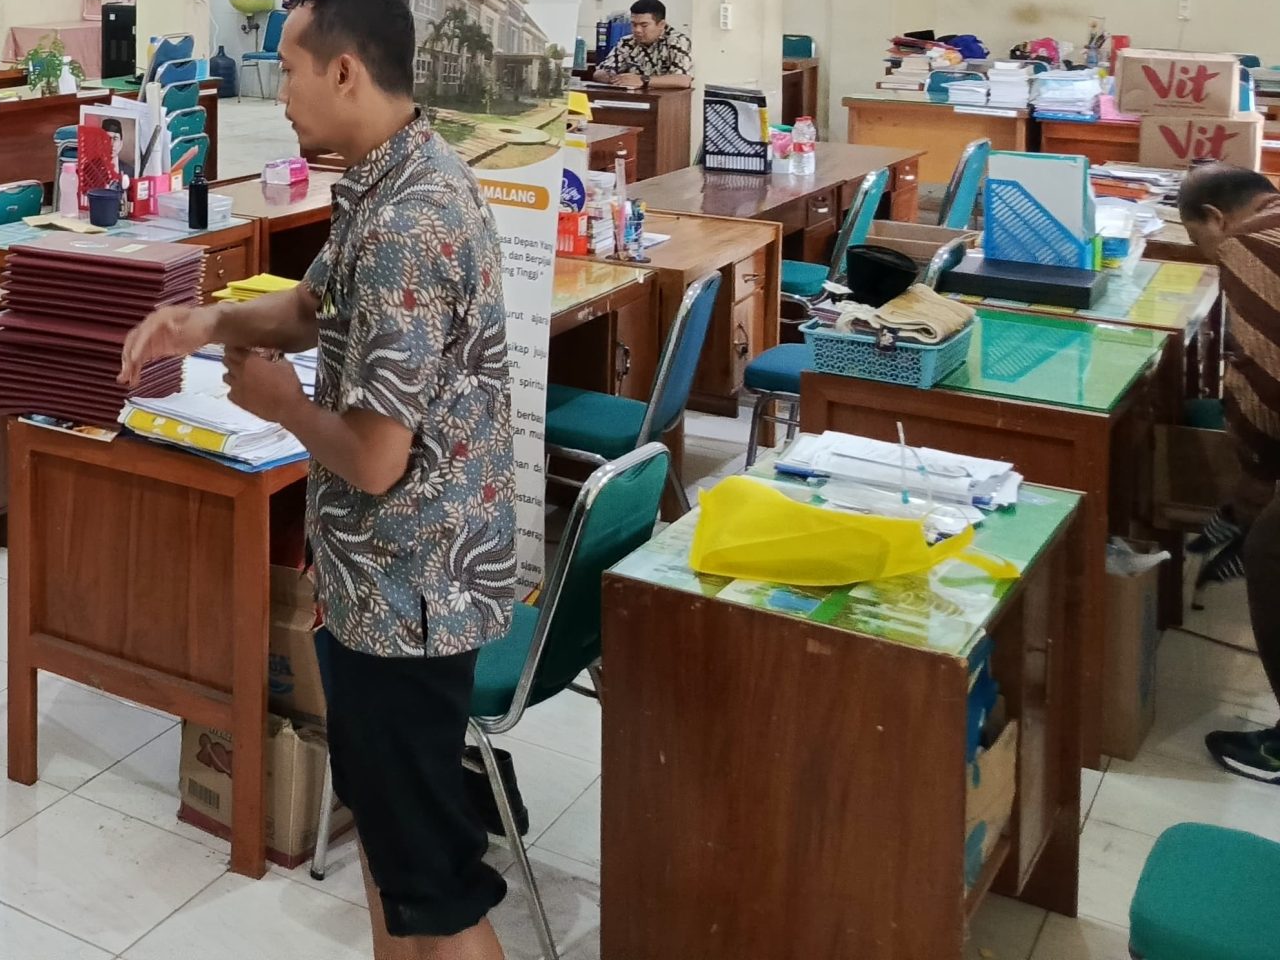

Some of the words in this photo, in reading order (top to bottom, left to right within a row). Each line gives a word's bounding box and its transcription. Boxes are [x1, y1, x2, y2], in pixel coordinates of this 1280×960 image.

[1141, 61, 1220, 103] Vit
[1158, 120, 1239, 161] Vit
[483, 185, 536, 204] MALANG
[514, 236, 539, 249] Depan
[508, 251, 524, 261] dan
